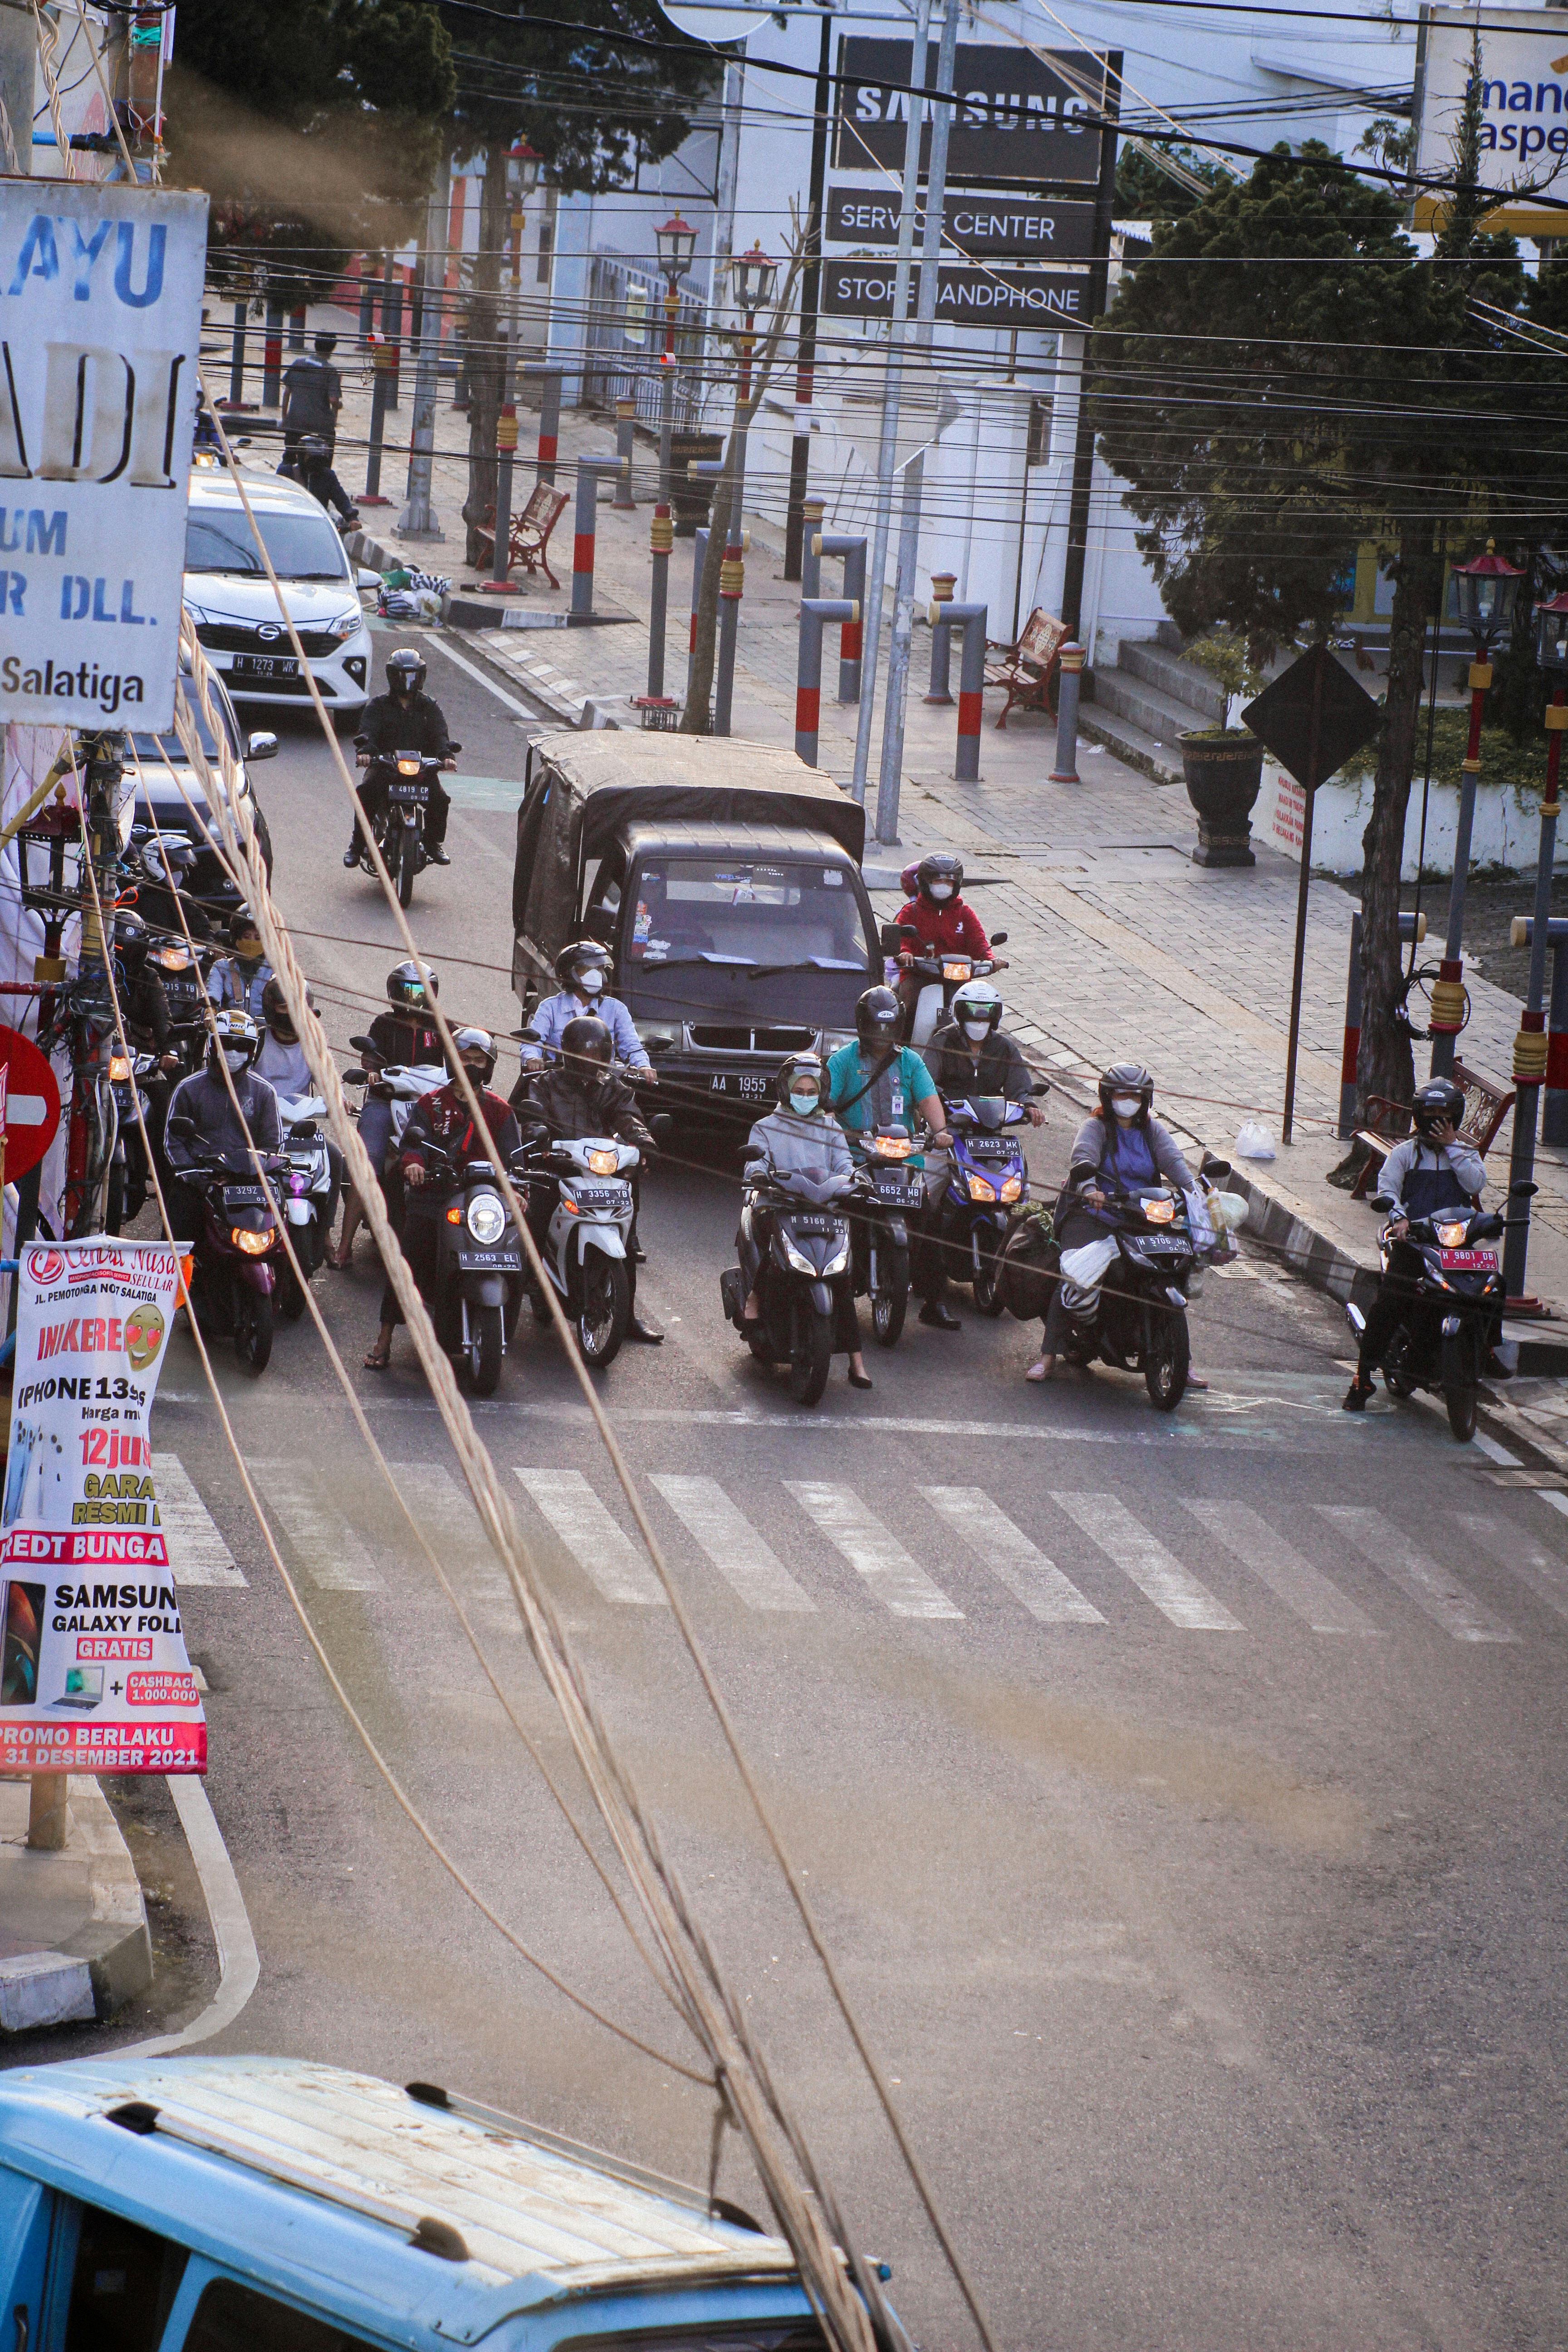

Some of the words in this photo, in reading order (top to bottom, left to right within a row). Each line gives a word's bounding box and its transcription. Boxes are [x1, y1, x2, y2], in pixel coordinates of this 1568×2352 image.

[1467, 78, 1568, 113] man
[954, 212, 1055, 240] CENTER
[935, 283, 1079, 311] ANDPHONE
[60, 575, 158, 626] DLL.
[237, 657, 243, 668] H
[252, 658, 274, 671] 1273
[283, 661, 294, 672] WK
[1, 656, 144, 713] Salatiga
[185, 985, 195, 993] TB
[712, 1075, 726, 1090] AA
[739, 1077, 766, 1092] 1955
[880, 1186, 901, 1195] 6652
[908, 1188, 919, 1196] MB
[804, 1216, 825, 1225] 5160
[1443, 1251, 1448, 1259] H
[1455, 1252, 1475, 1260] 9801
[130, 1273, 173, 1292] SELULAR
[34, 1294, 46, 1305] JL.
[121, 1288, 157, 1303] SALATIGA
[18, 1377, 91, 1409] IPHONE
[82, 1406, 119, 1421] Harga
[72, 1502, 147, 1525] RESMI
[73, 1535, 164, 1561] BUNGA
[52, 1615, 132, 1632] GALAXY
[78, 1640, 151, 1659] GRATIS
[132, 1688, 196, 1701] 1.000.000
[75, 1728, 174, 1745] BERLAKU
[5, 1747, 30, 1764] 31
[36, 1748, 144, 1765] DESEMBER
[149, 1749, 198, 1765] 2021
